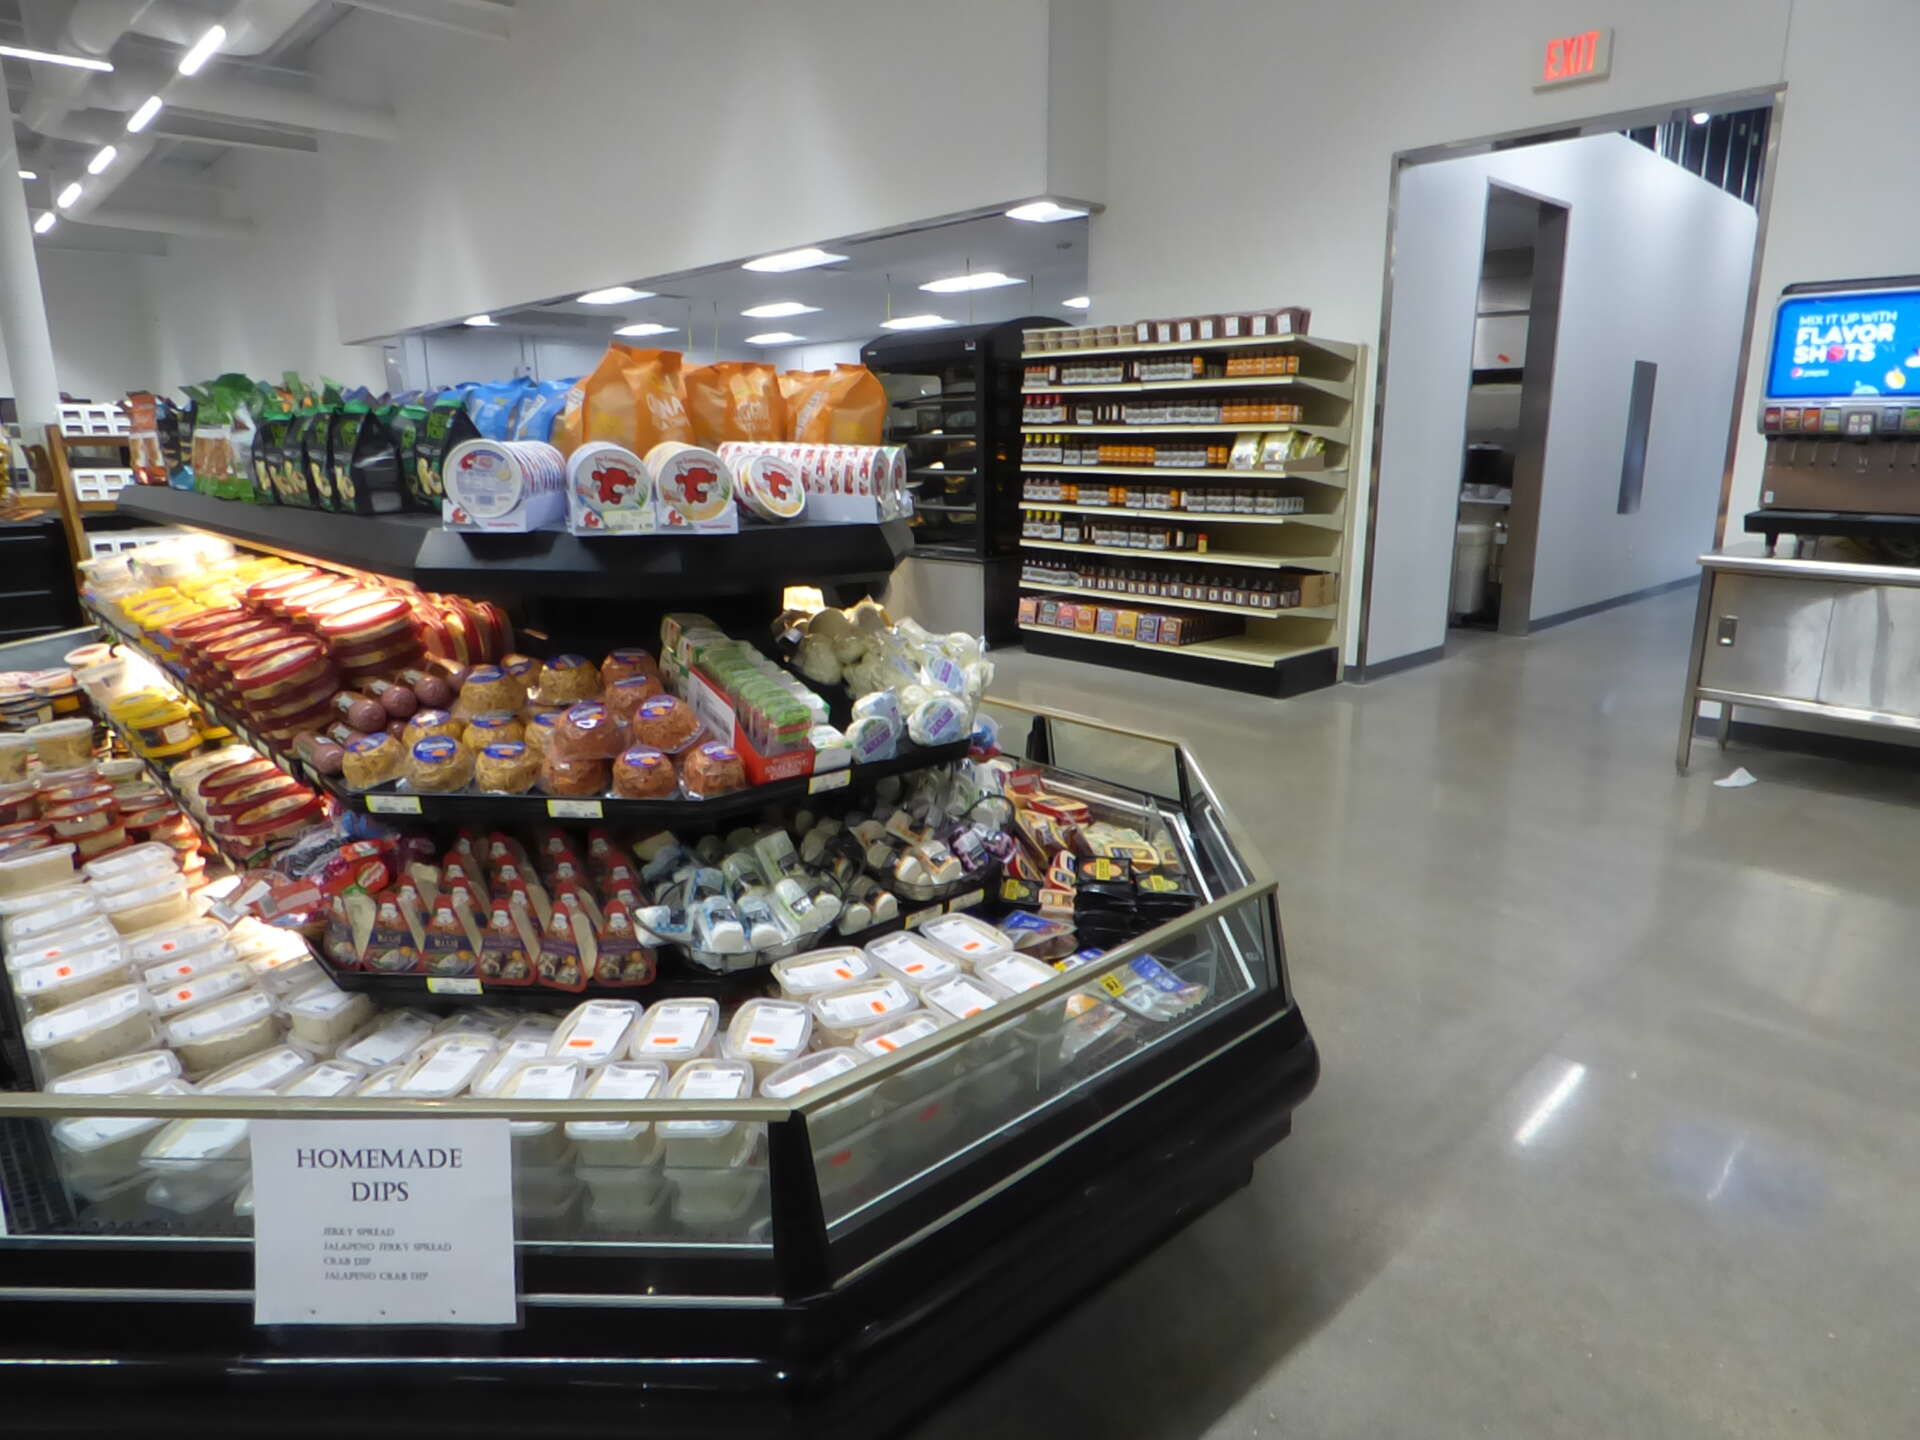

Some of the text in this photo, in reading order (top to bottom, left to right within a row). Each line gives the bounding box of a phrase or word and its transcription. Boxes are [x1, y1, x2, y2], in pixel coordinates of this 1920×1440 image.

[1543, 30, 1600, 81] EXIT
[1799, 310, 1898, 326] MIX IT UP WITH
[1797, 323, 1896, 346] FLAVOR
[297, 1148, 463, 1169] HOMEMADE
[352, 1181, 409, 1202] DIPS
[323, 1227, 395, 1237] JERKY SPREAD
[379, 1242, 409, 1251] JERKY
[413, 1242, 452, 1251] SPREAD
[323, 1256, 371, 1266] CRAB DIP
[379, 1272, 408, 1280] CRAB
[411, 1272, 429, 1280] DIP
